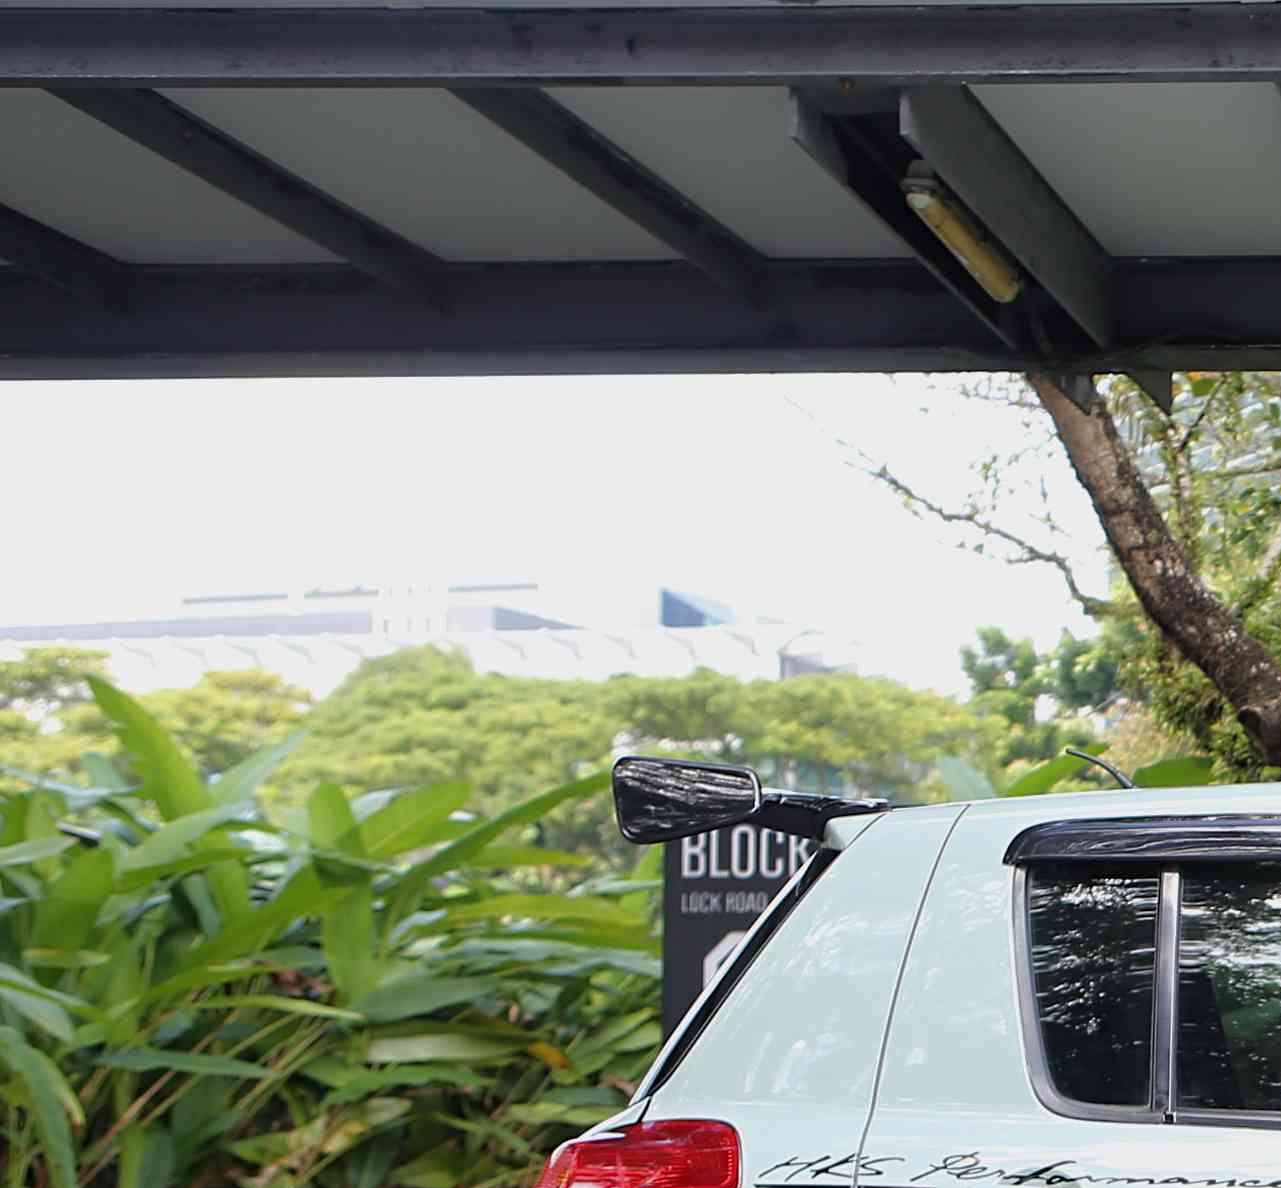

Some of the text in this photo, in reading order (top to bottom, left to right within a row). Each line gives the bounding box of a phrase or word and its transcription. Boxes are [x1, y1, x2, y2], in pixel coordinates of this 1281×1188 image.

[681, 824, 812, 878] BLOCK
[681, 892, 768, 913] LOCK ROAD
